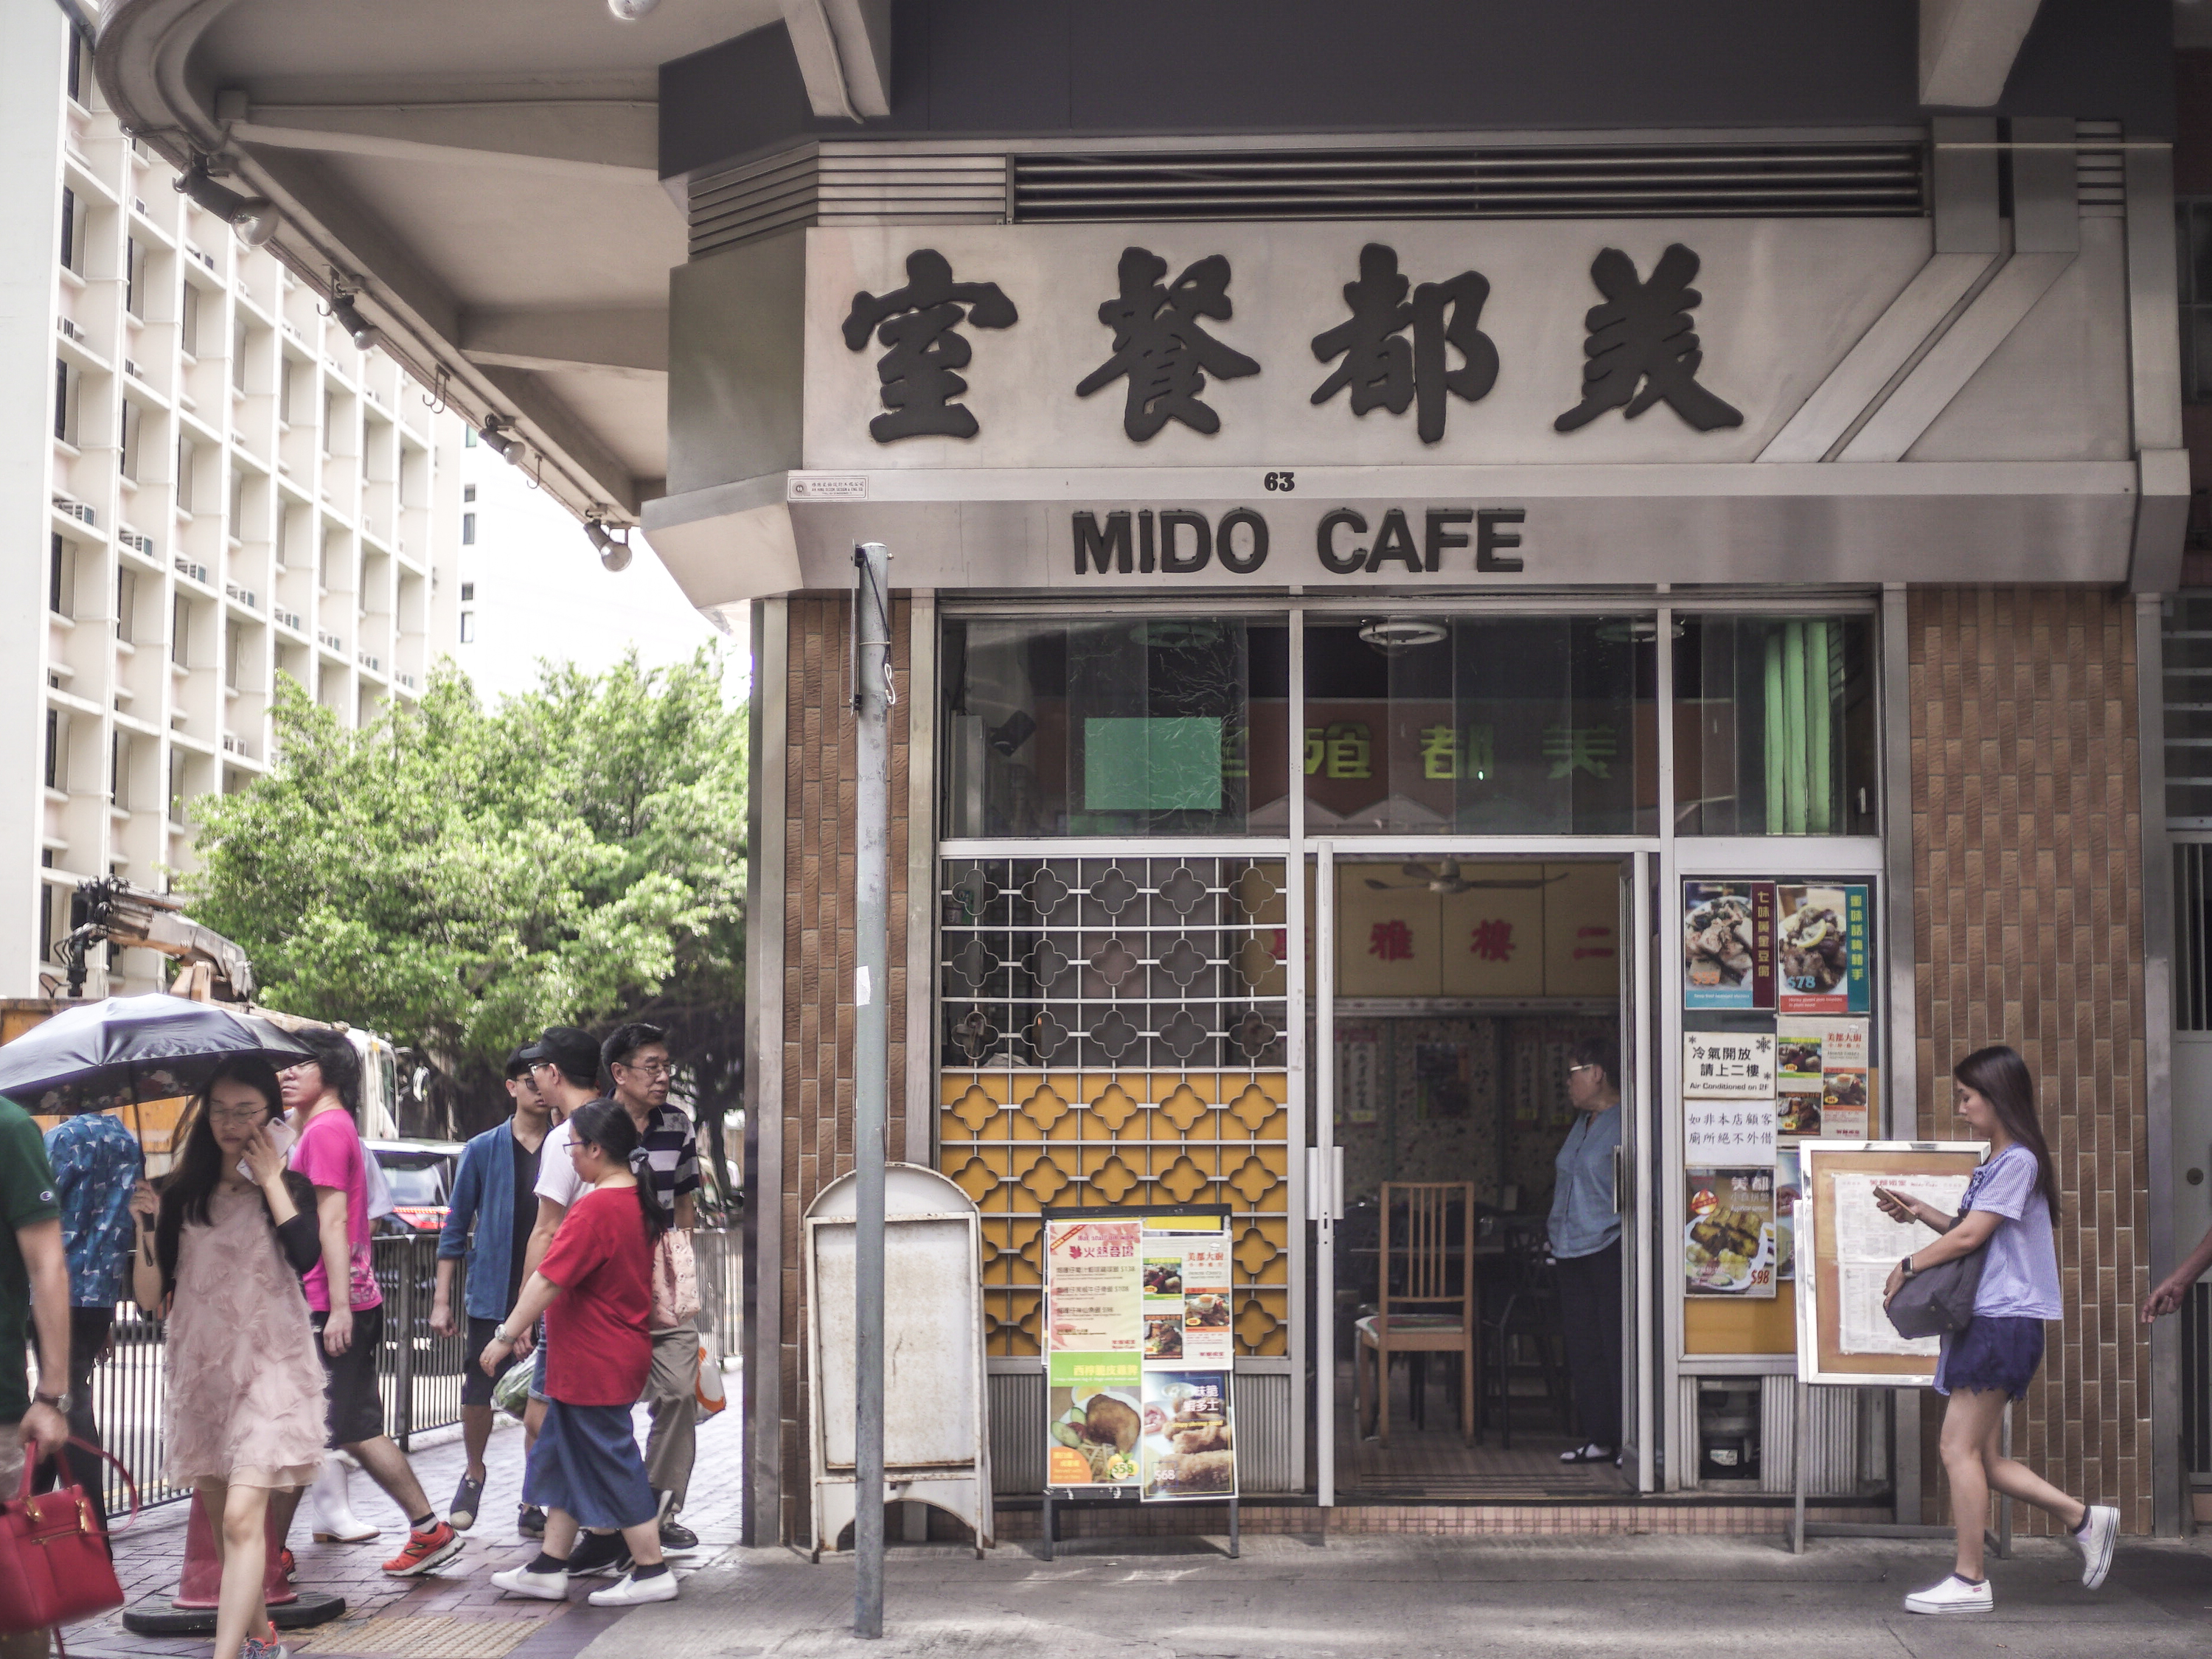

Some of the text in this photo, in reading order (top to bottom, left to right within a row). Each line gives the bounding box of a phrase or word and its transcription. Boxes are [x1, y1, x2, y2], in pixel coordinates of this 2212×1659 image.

[841, 243, 1745, 445] 美都餐室
[1264, 472, 1295, 492] 63
[1072, 507, 1526, 575] MIDO CAFE
[1787, 975, 1816, 989] $78
[1692, 1046, 1751, 1060] 冷氣開放
[1700, 1063, 1759, 1077] 請上二樓
[1688, 1112, 1773, 1126] 如非本店顧客
[1689, 1131, 1773, 1145] 廁所絕不外借
[1751, 1270, 1770, 1284] $98
[1113, 1464, 1134, 1474] $58
